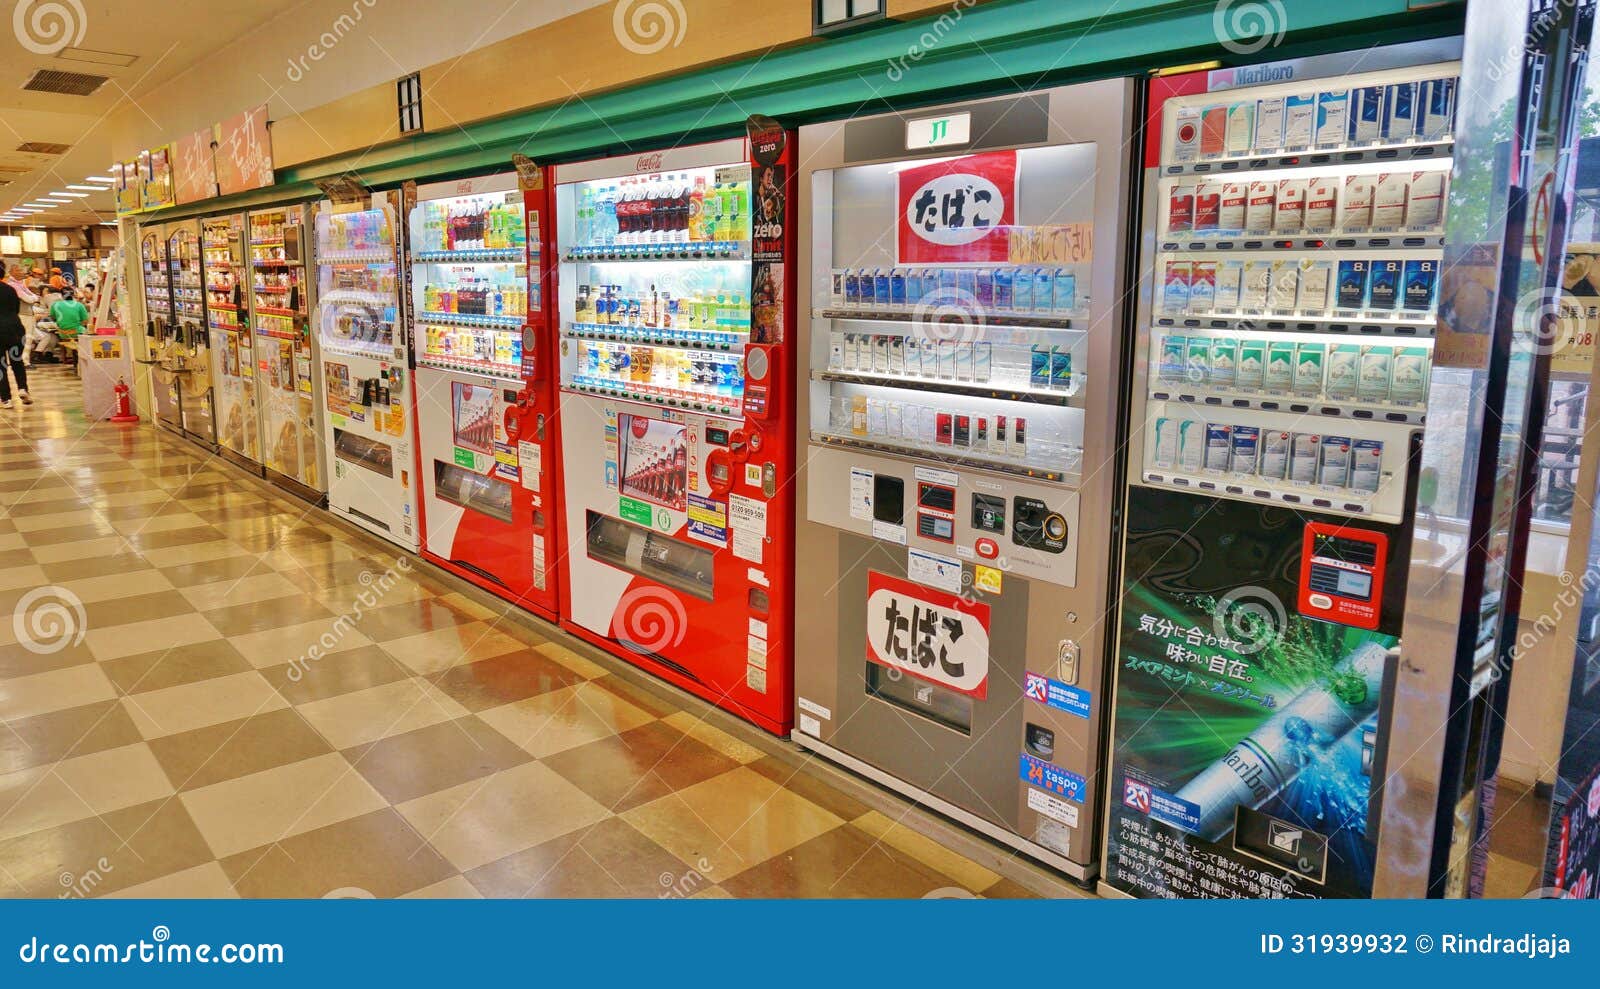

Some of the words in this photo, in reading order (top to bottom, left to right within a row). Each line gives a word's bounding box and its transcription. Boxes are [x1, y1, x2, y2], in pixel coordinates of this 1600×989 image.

[1236, 65, 1293, 85] Marlboro
[929, 119, 950, 144] JT
[915, 184, 992, 232] たばこ
[885, 598, 965, 678] たばこ
[1166, 642, 1255, 683] 味わい自在。
[1026, 679, 1047, 703] 20
[1045, 769, 1078, 792] taspo
[1126, 786, 1149, 812] 20
